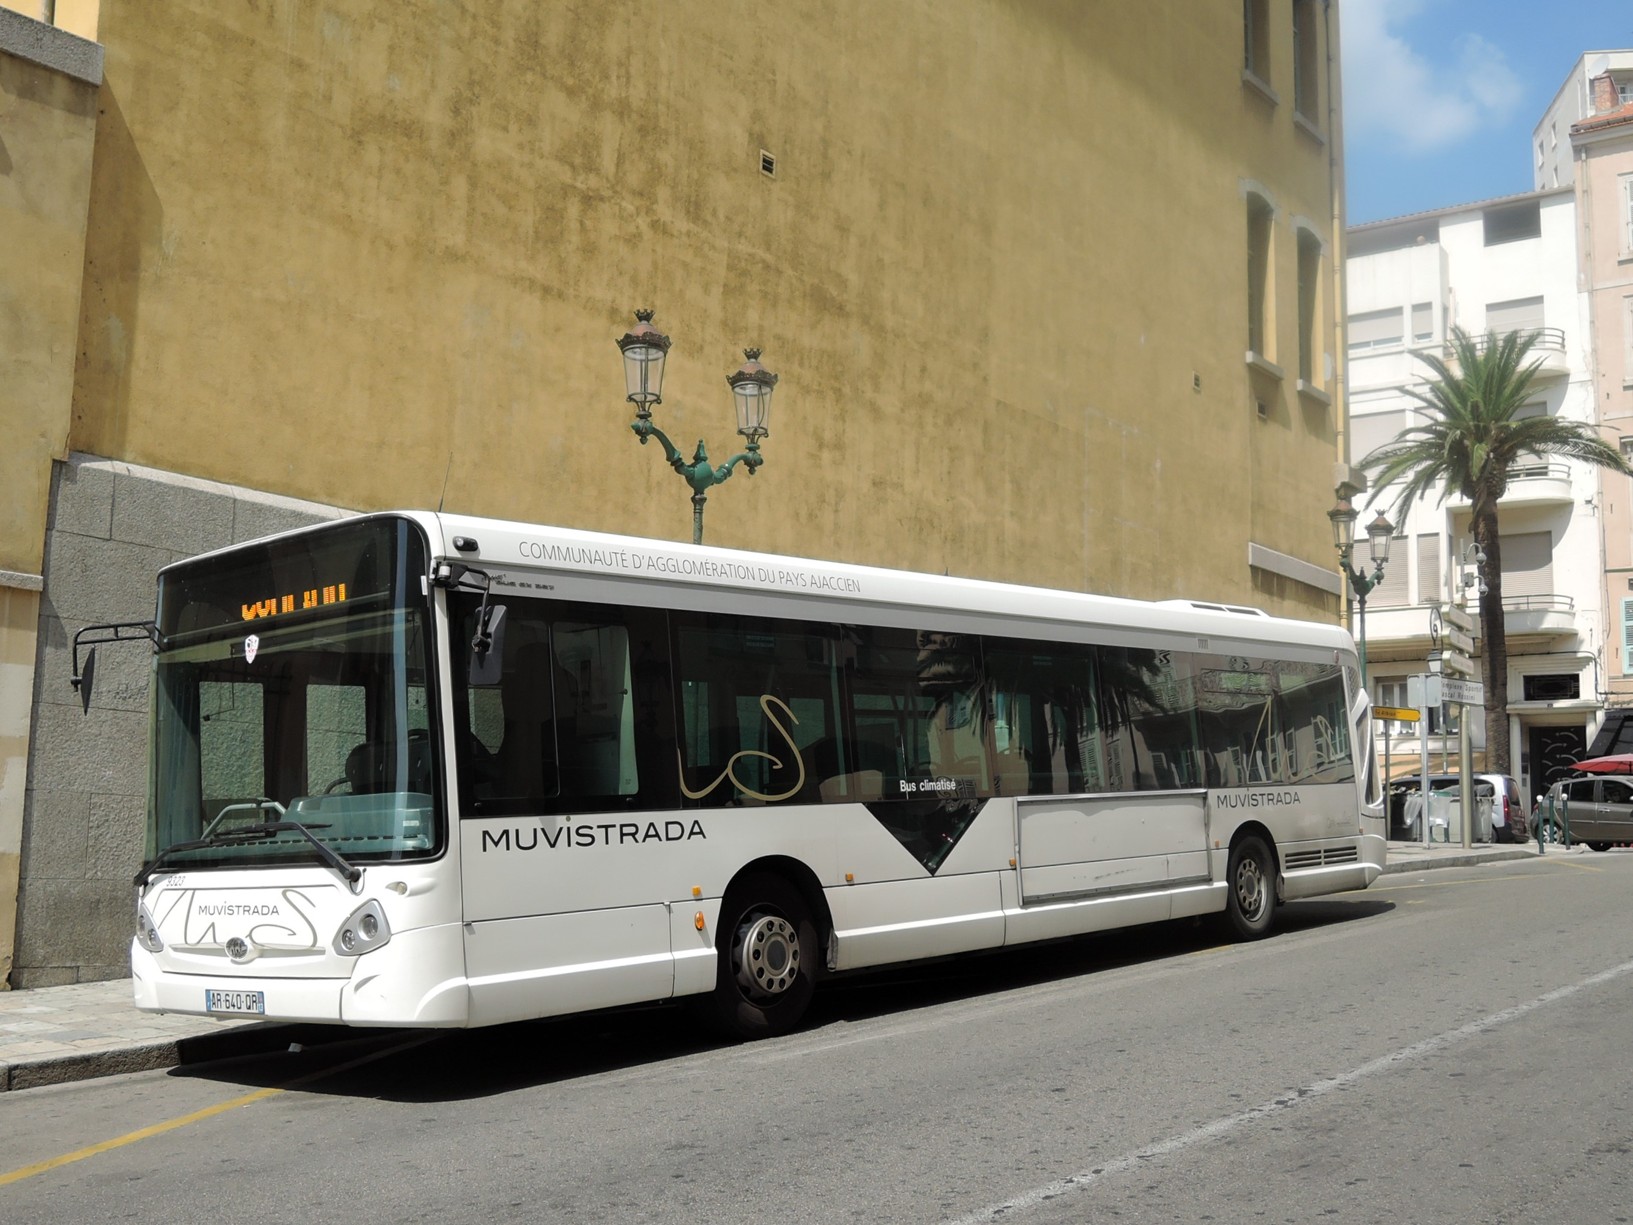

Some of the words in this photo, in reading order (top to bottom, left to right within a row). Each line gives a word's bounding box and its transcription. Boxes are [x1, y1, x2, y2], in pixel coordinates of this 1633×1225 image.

[518, 541, 629, 568] COMMUNAUTÉ
[631, 553, 756, 581] D'AGGLOMÉRATION
[758, 567, 776, 584] DU
[778, 570, 807, 587] PAYS
[810, 574, 861, 593] AJACCIEN
[1441, 681, 1462, 691] omplexe
[900, 779, 917, 792] Bus
[919, 778, 957, 791] climatisé
